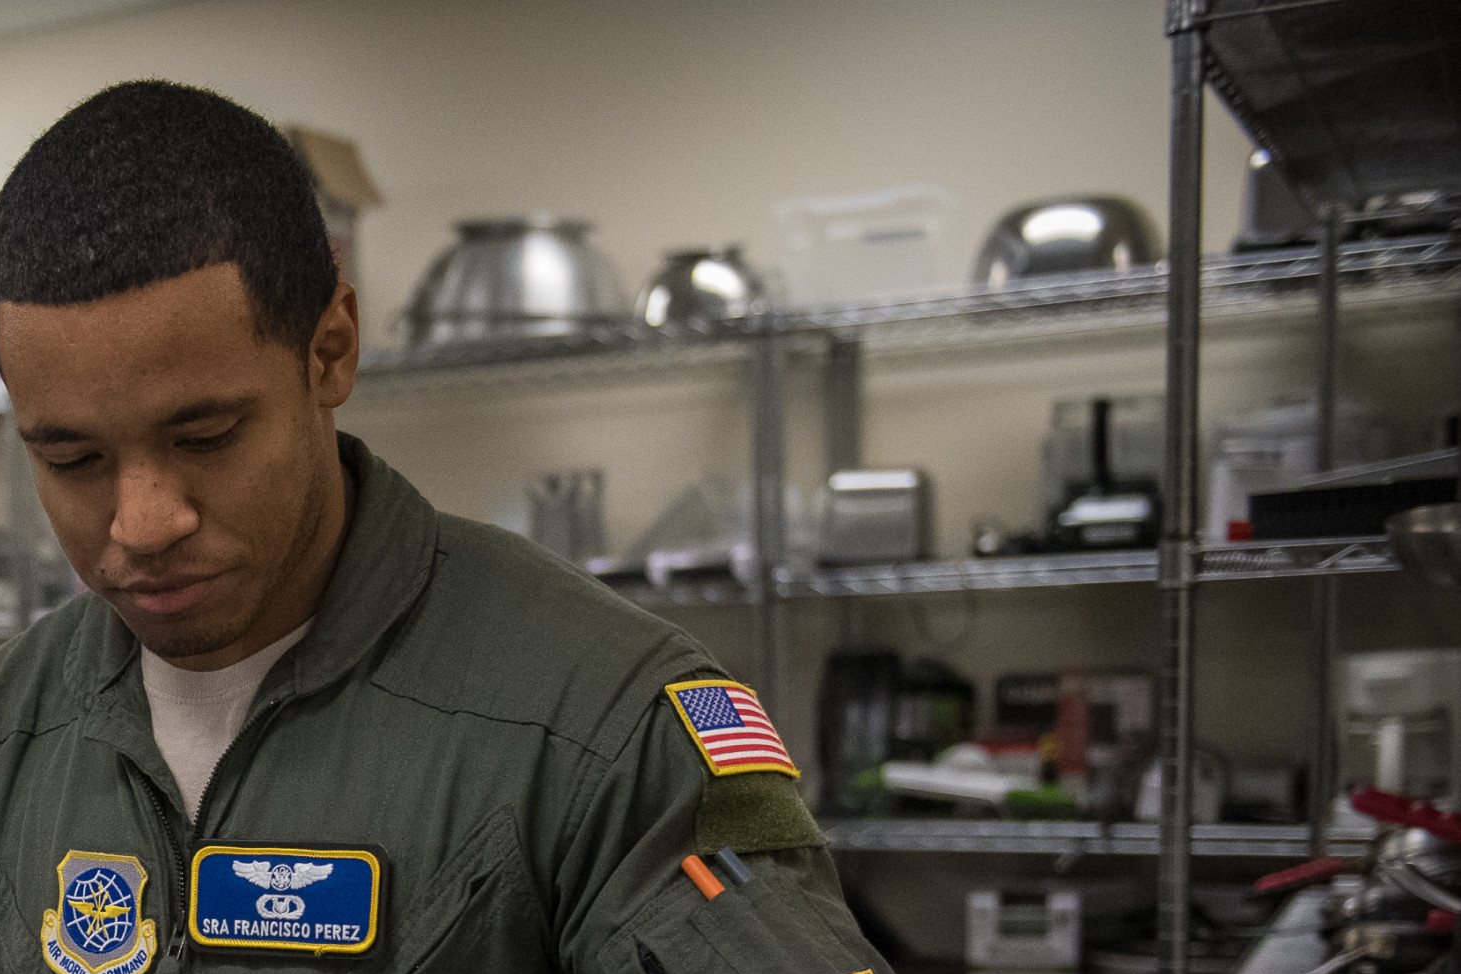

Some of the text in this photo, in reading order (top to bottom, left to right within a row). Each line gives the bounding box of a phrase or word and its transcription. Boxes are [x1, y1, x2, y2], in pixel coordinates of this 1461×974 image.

[202, 918, 361, 942] SRA FRANCISCO PEREZ
[47, 939, 62, 961] AIR
